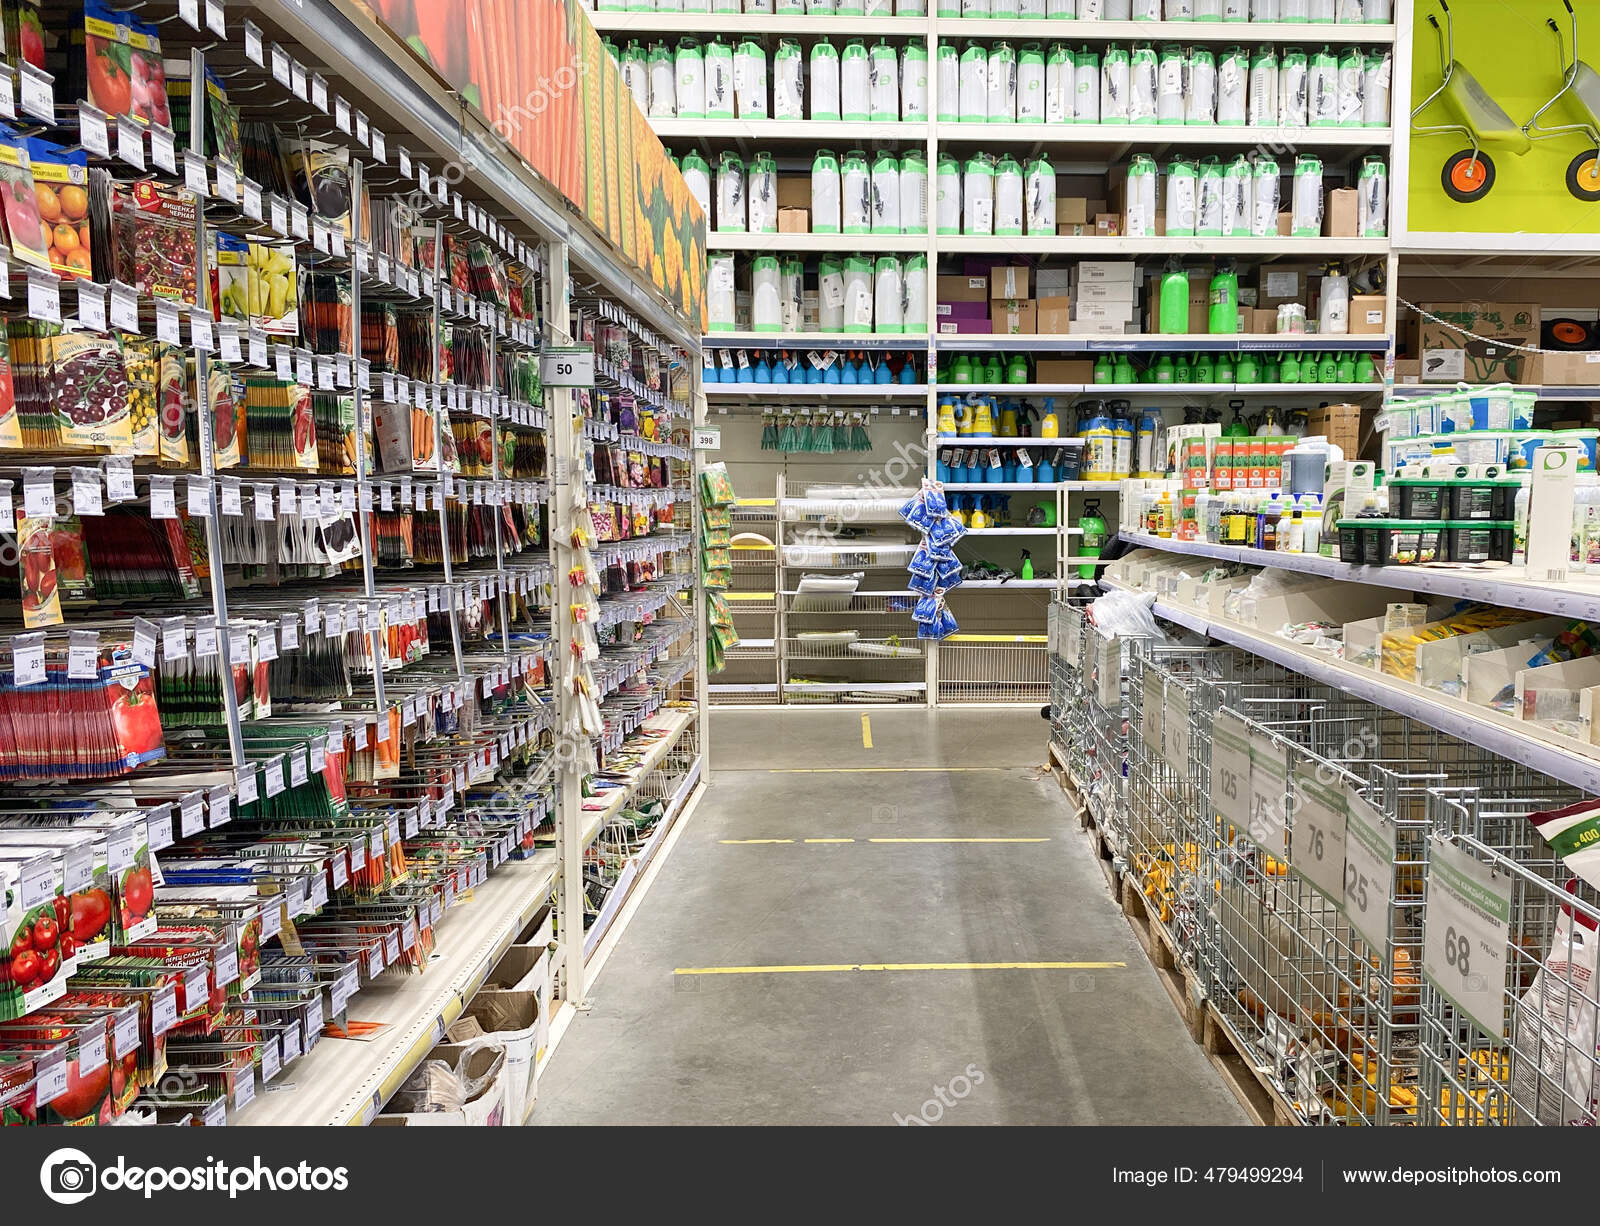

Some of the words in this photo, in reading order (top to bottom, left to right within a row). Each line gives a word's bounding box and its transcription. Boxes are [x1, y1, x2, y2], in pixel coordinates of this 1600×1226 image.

[162, 202, 195, 213] ВИШЕНКА
[169, 210, 195, 220] ЧЕРНАЯ
[154, 286, 181, 295] АЭЛИТА
[556, 364, 573, 375] 50
[700, 436, 714, 445] 398
[31, 660, 39, 669] 25
[1220, 768, 1237, 801] 125
[1579, 828, 1599, 843] 400
[1308, 824, 1324, 861] 76
[1348, 863, 1368, 914] 25
[1445, 926, 1470, 977] 68
[165, 955, 183, 964] ПЕРЕЦ
